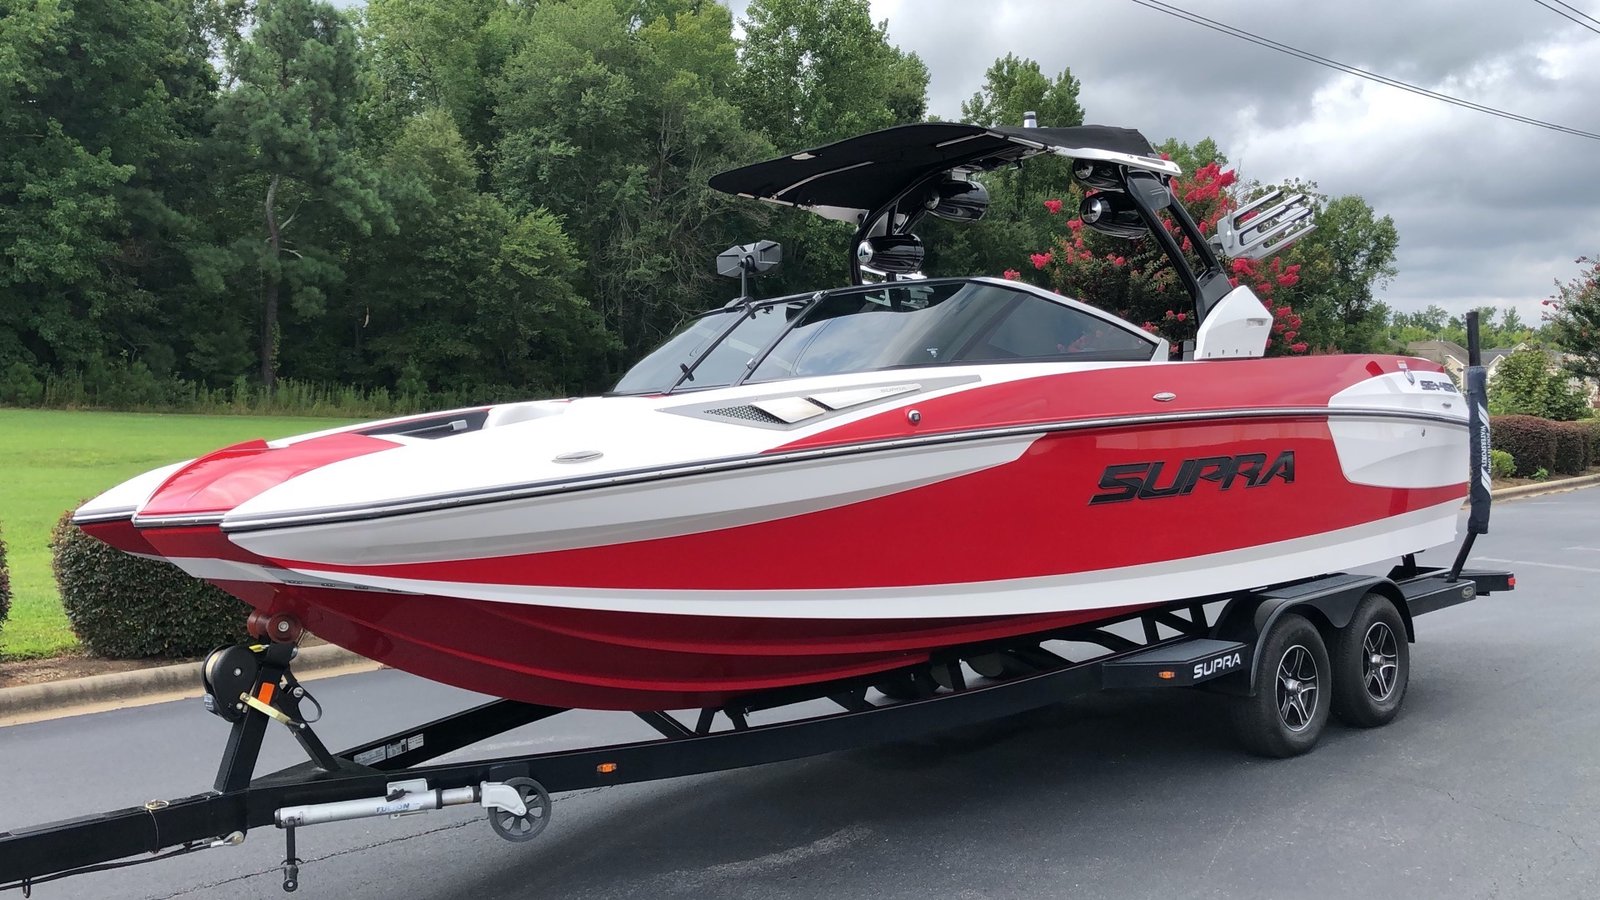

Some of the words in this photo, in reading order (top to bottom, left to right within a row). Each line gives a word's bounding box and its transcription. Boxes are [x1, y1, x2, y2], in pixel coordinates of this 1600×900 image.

[1088, 450, 1295, 505] SUPRA
[1193, 652, 1241, 679] SUPRA
[376, 803, 410, 812] FUON
